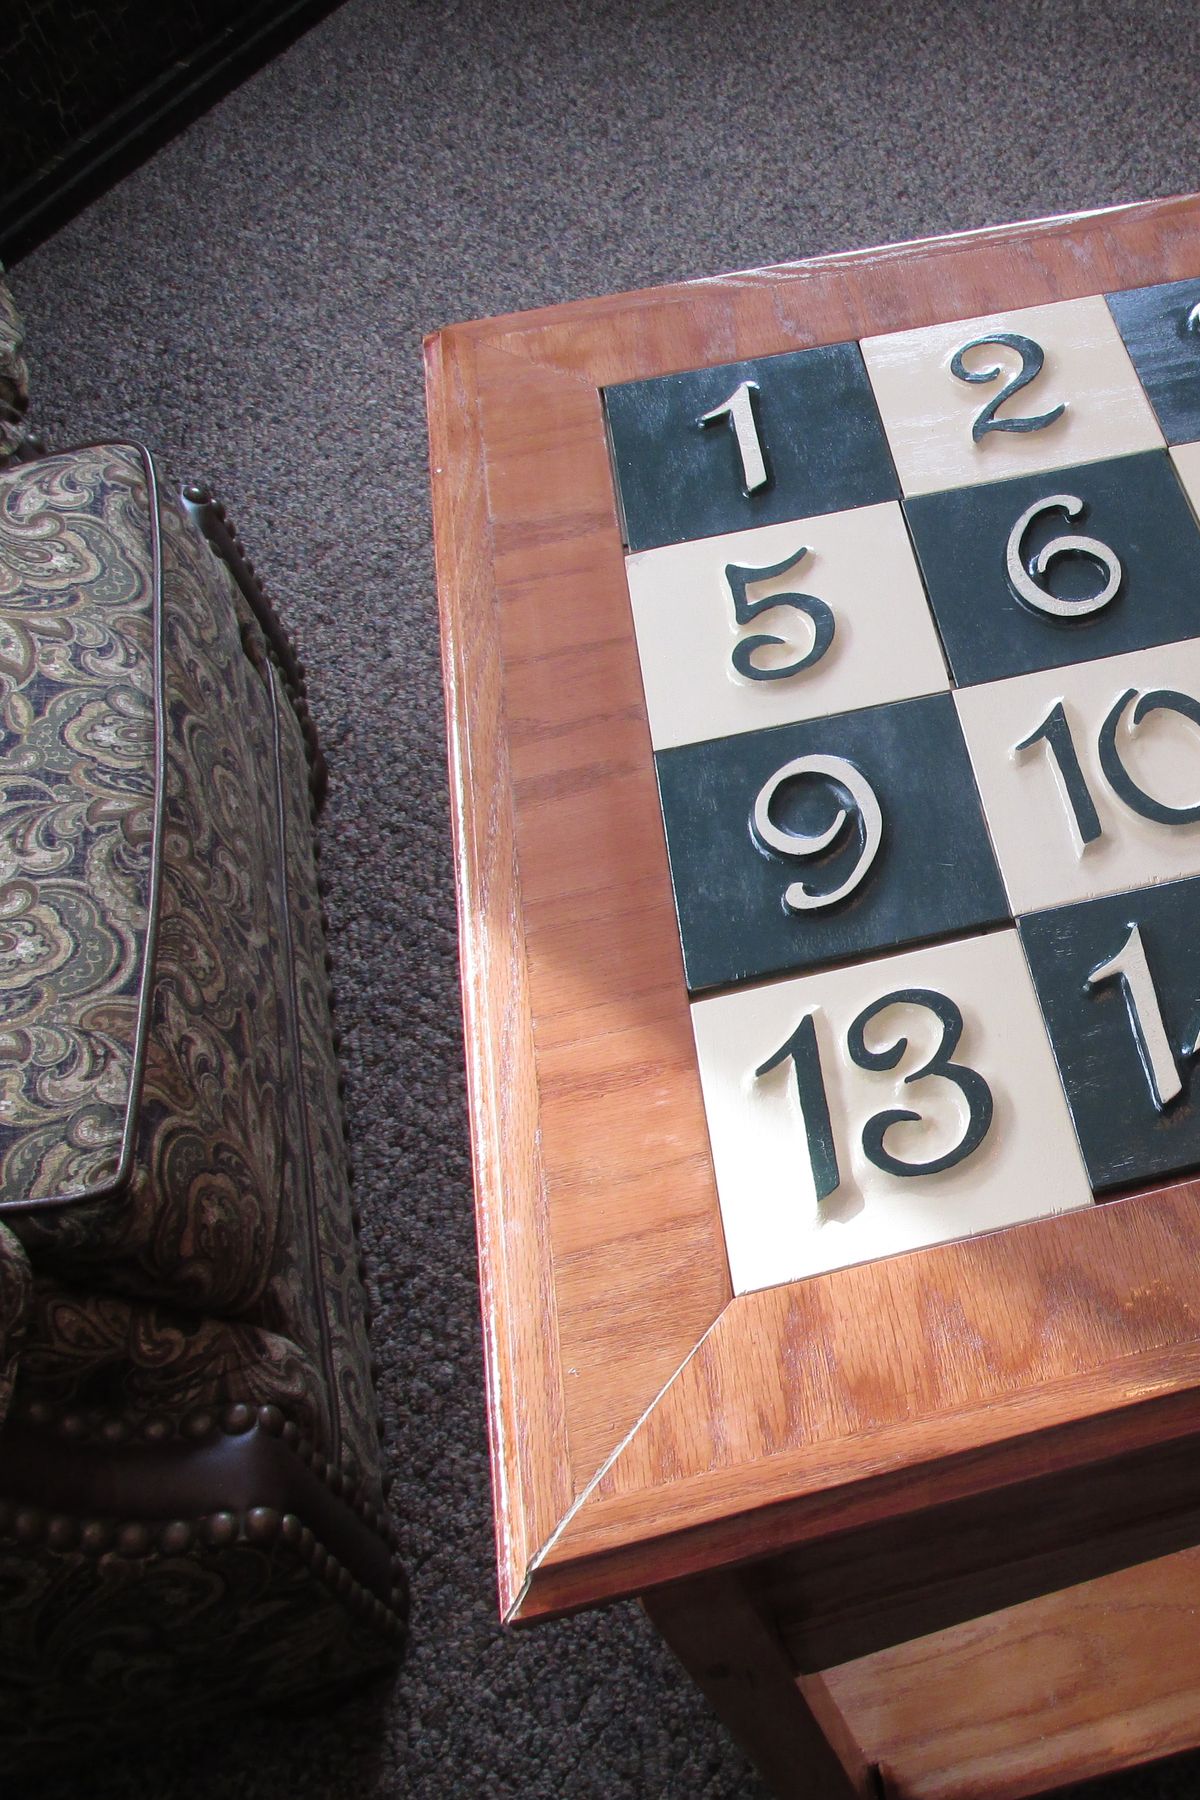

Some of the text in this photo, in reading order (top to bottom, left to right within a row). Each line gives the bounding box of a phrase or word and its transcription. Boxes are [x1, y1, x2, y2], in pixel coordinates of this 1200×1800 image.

[697, 382, 768, 495] 1
[950, 332, 1066, 444] 2
[726, 547, 834, 681] 5
[1006, 495, 1122, 618] 6
[752, 753, 885, 910] 9
[754, 987, 995, 1204] 13
